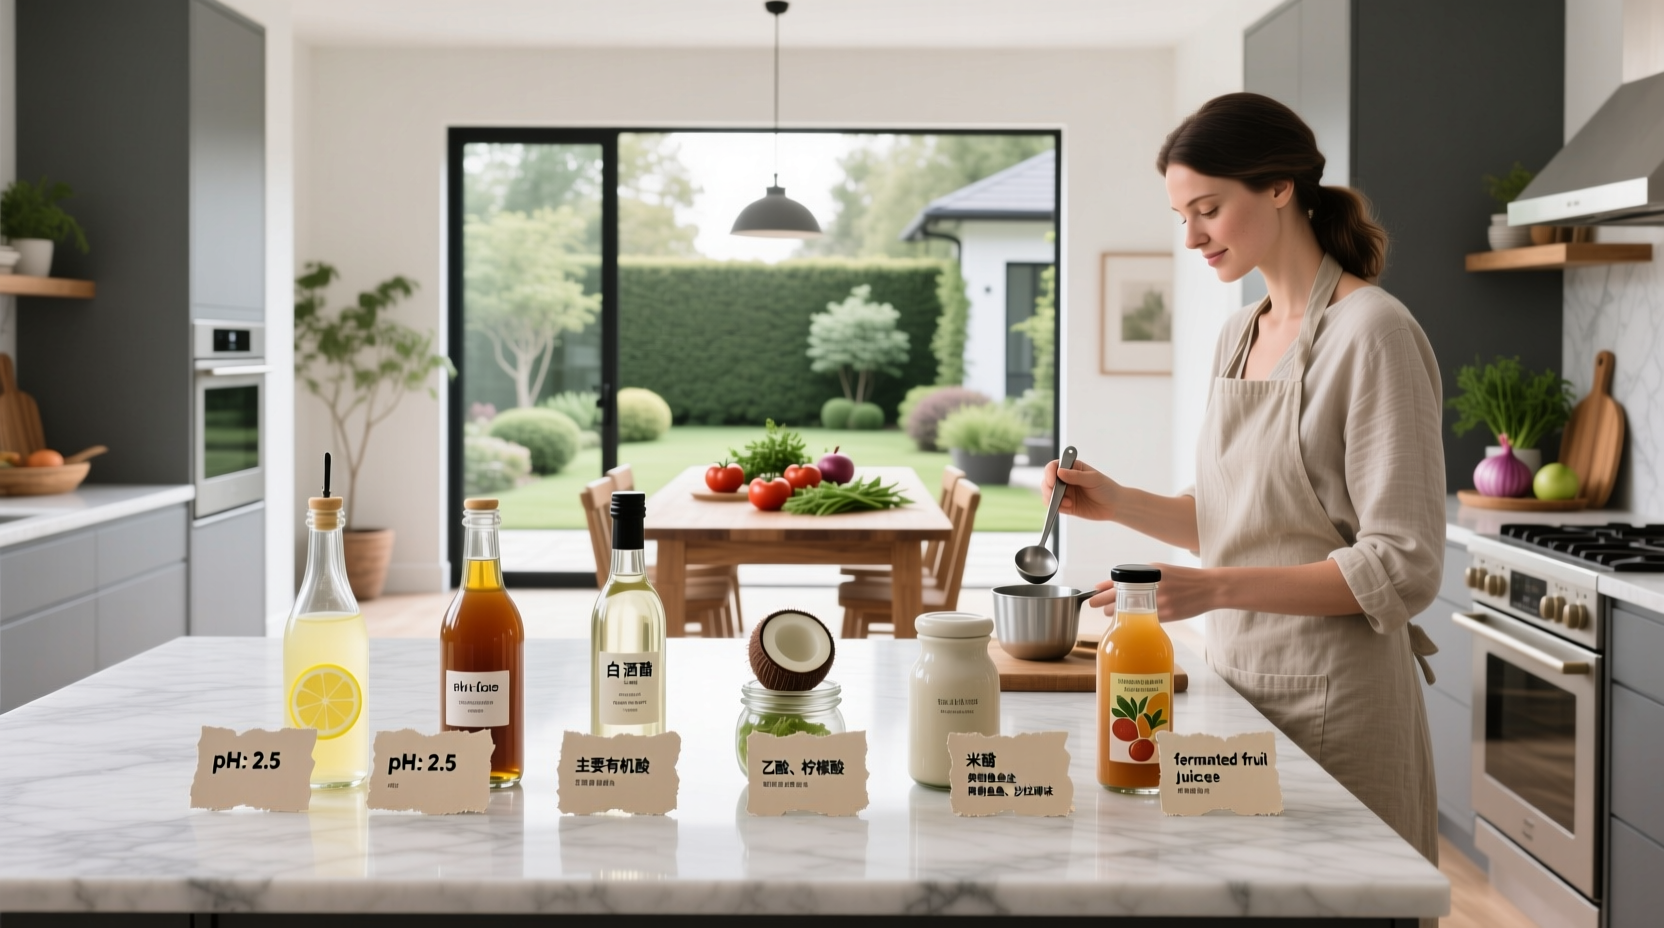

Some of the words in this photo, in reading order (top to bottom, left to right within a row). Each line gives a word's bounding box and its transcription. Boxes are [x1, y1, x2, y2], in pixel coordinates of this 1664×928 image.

[212, 751, 248, 775] pH:
[251, 750, 281, 770] 2.5
[387, 753, 423, 776] pH:
[427, 753, 457, 772] 2.5
[575, 756, 650, 775] 主要有机酸
